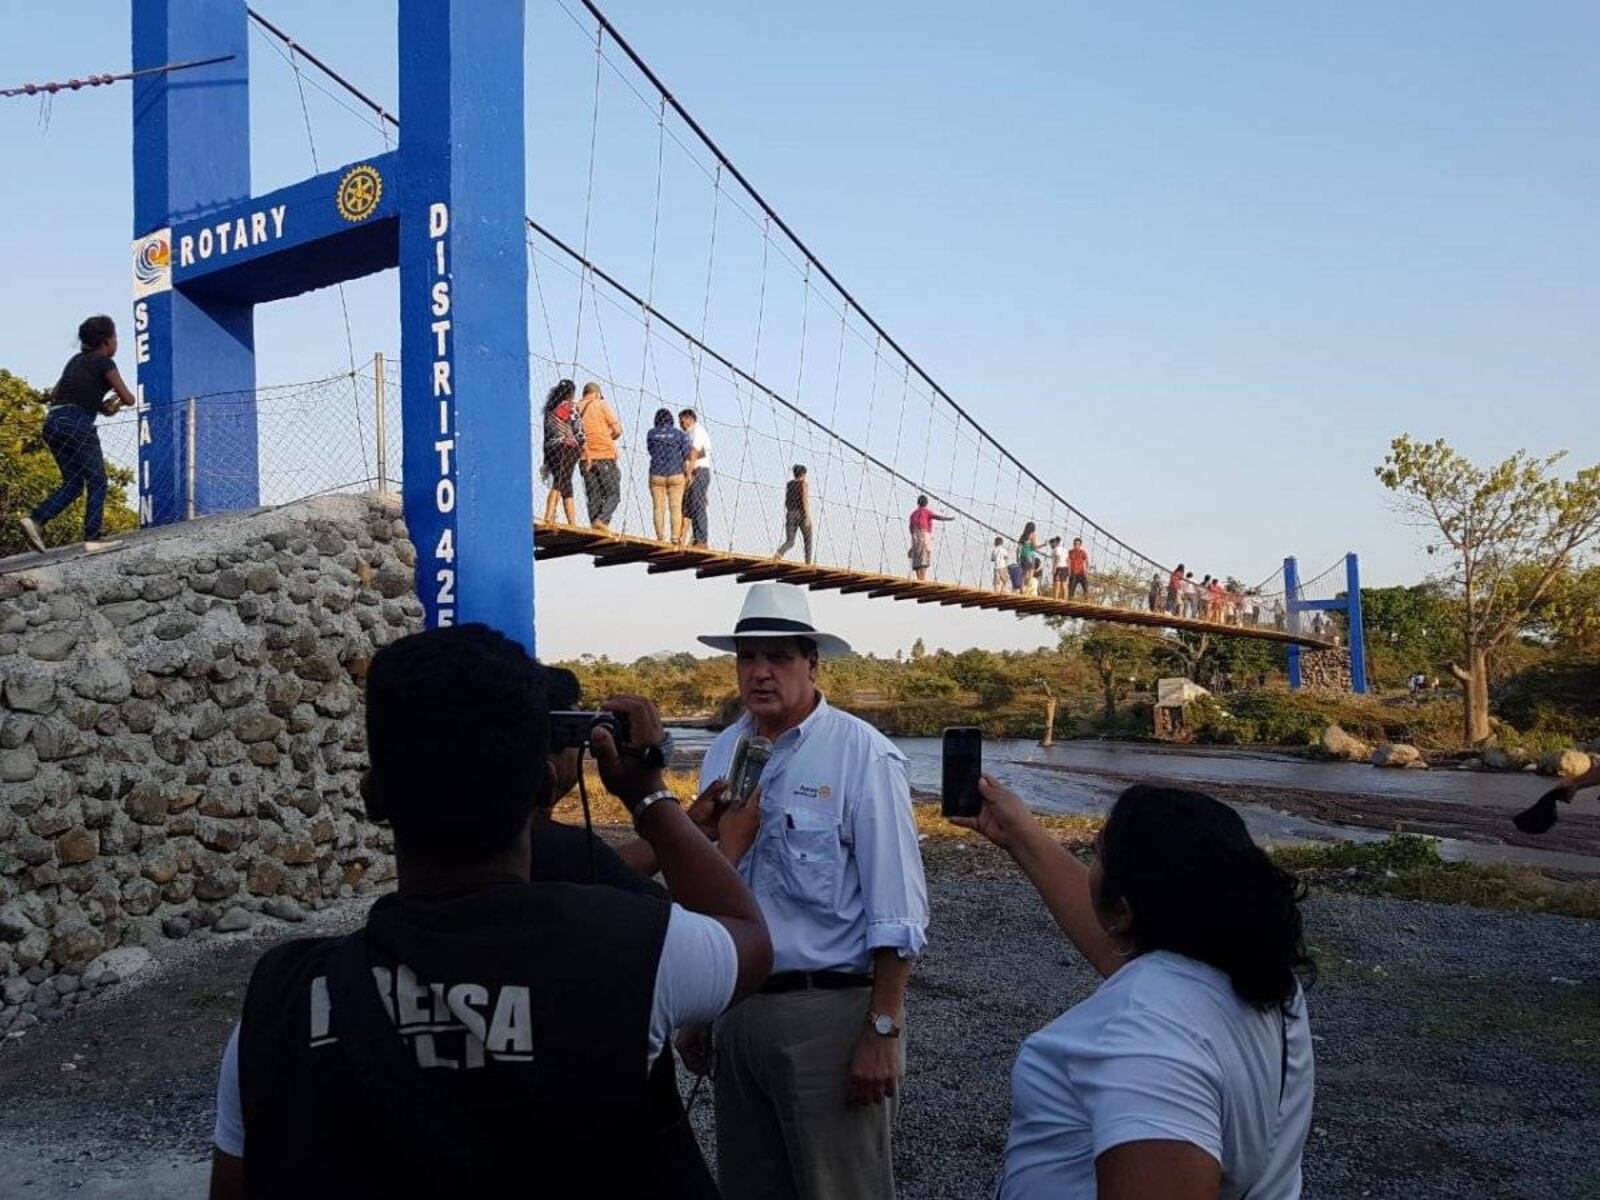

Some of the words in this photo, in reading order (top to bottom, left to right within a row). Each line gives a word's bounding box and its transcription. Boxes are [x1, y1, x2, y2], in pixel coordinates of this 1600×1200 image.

[180, 204, 286, 268] ROTARY
[135, 302, 151, 364] SE
[429, 202, 456, 514] DISTRITO
[138, 383, 152, 446] LA
